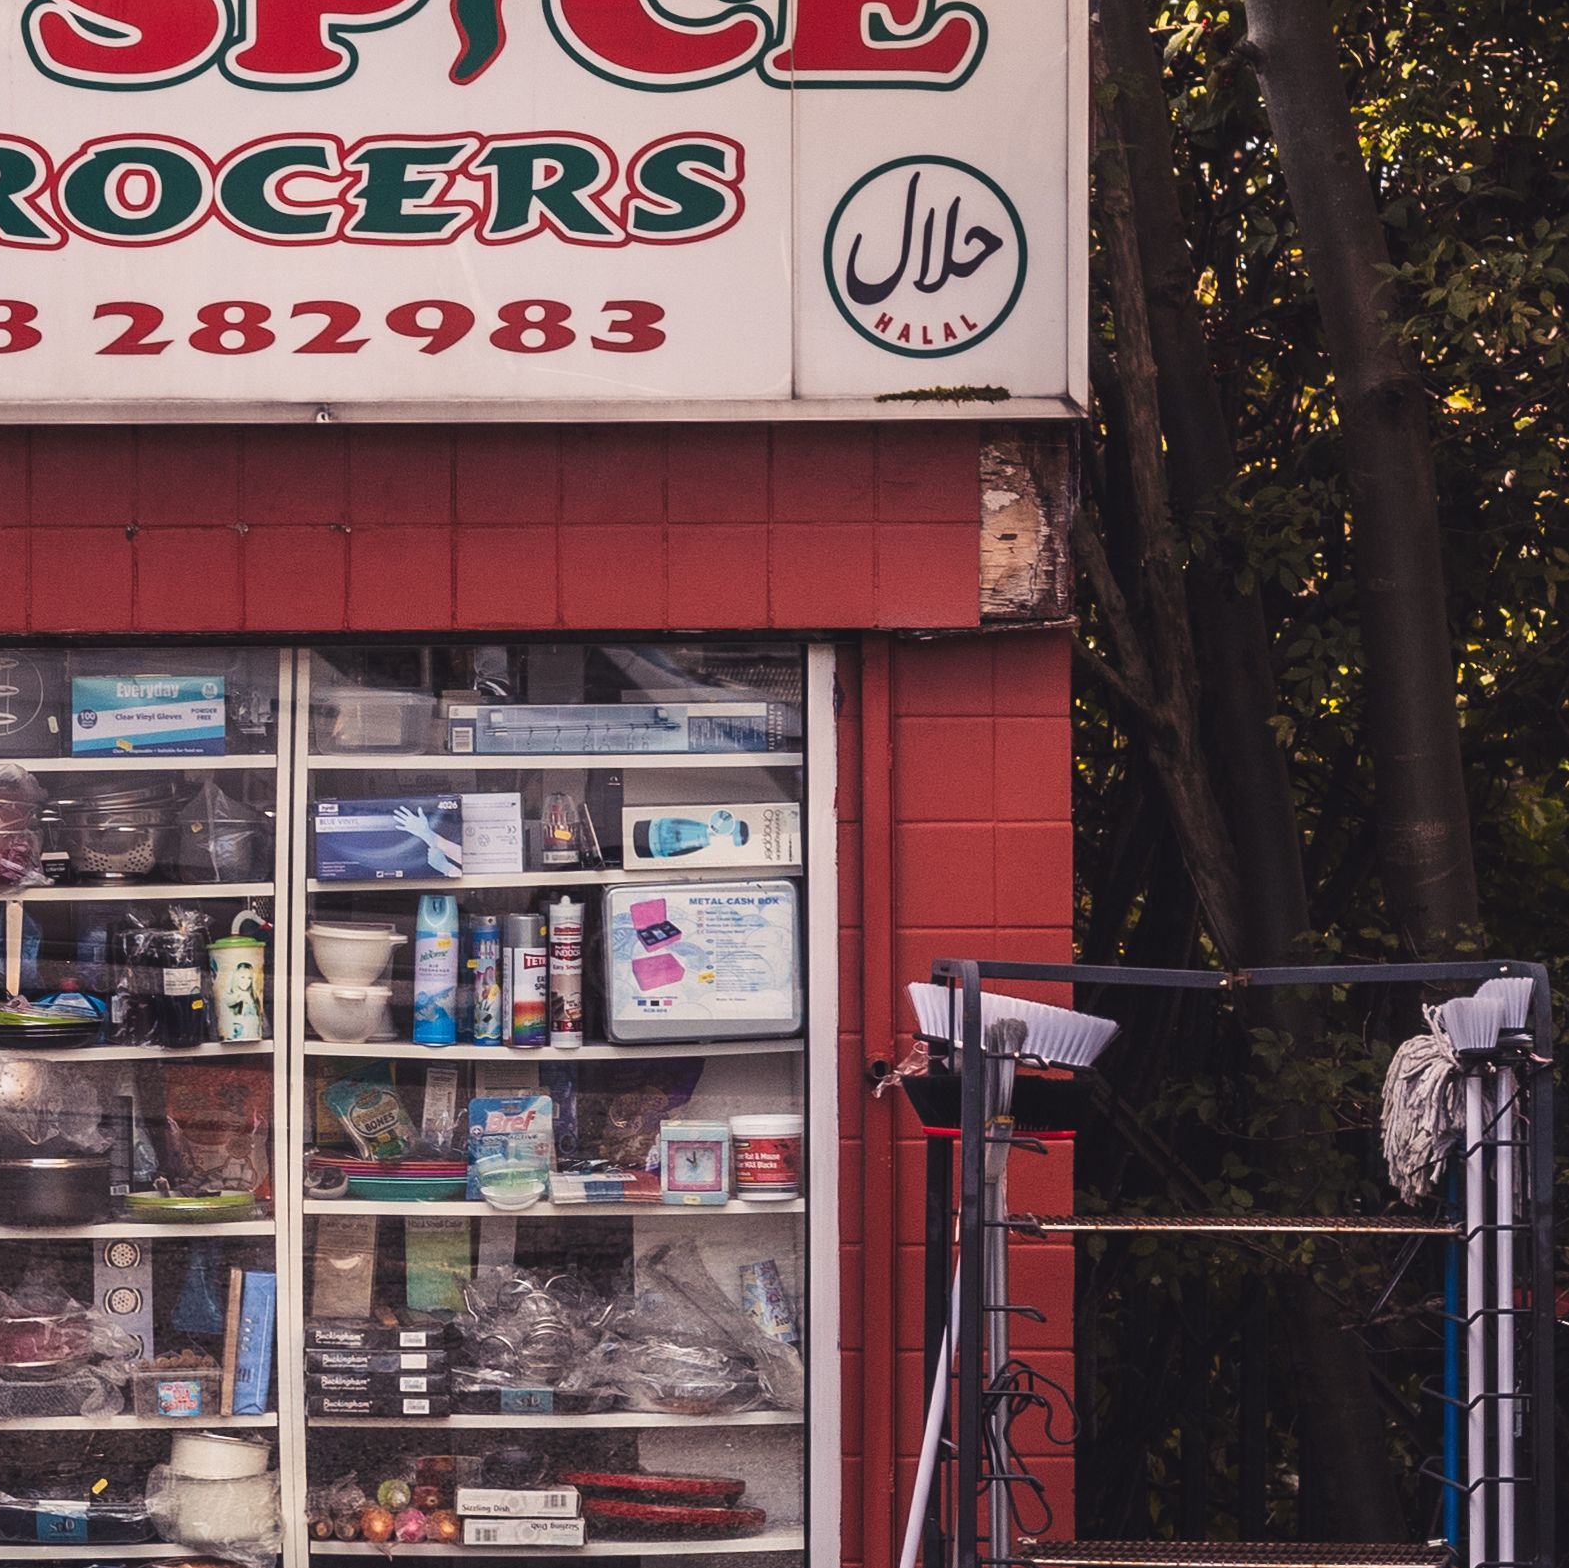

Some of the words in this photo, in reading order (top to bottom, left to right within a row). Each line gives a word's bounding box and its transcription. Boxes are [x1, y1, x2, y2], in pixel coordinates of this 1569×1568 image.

[847, 171, 1003, 305] حلال
[92, 298, 667, 355] 282983
[873, 310, 980, 345] HALAL
[116, 682, 180, 698] Everyday
[81, 711, 96, 720] 100
[135, 713, 155, 722] Vinyl
[437, 801, 459, 809] 4026
[726, 897, 755, 905] CASH
[758, 897, 780, 905] BOX
[364, 1112, 396, 1133] BONES
[487, 1110, 537, 1132] Bref
[315, 1330, 363, 1342] Buckingham
[322, 1354, 370, 1364] Buckingham
[321, 1376, 370, 1386] Buckingham
[323, 1398, 371, 1409] Buckingham
[462, 1504, 491, 1513] Sizzling
[531, 1523, 548, 1531] Dish
[550, 1522, 580, 1531] Sizzling
